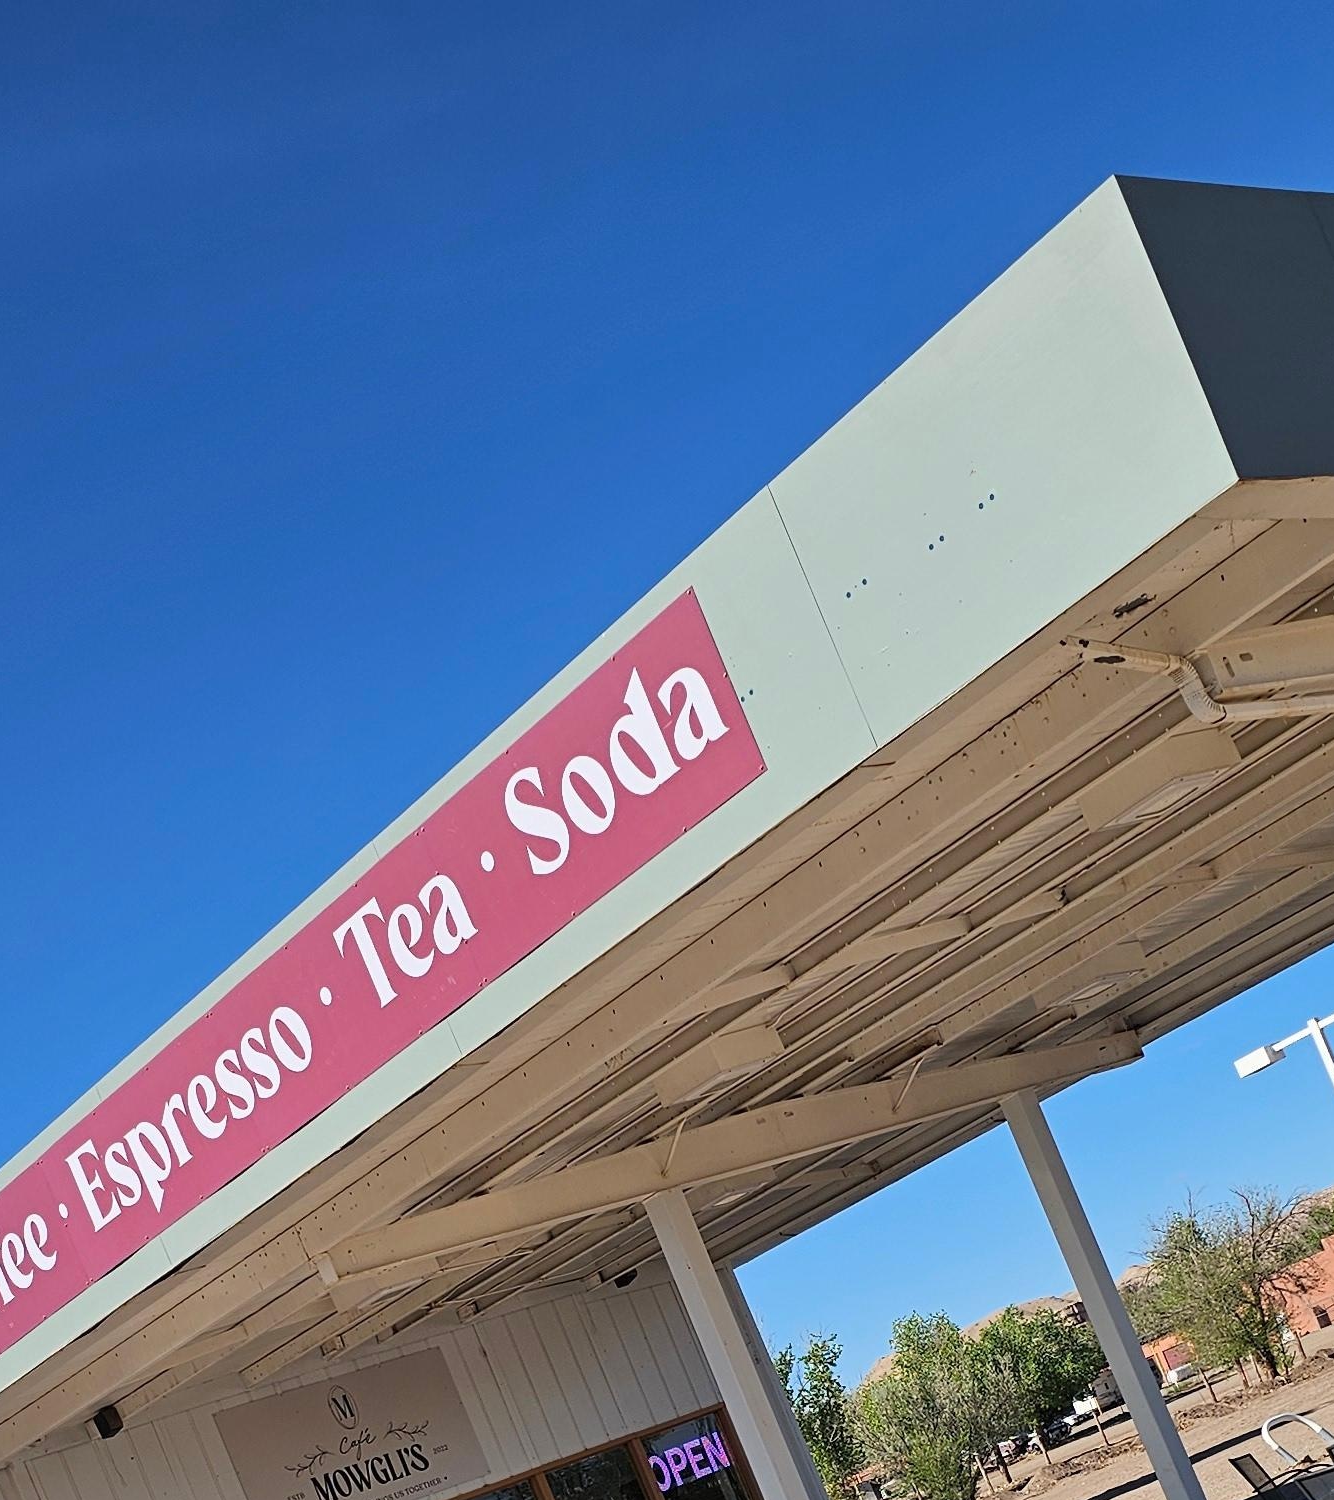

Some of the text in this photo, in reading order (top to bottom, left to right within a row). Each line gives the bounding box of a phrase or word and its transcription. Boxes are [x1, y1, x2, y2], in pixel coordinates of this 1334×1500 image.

[66, 1004, 313, 1232] Espresso
[333, 873, 477, 1008] Tea
[504, 666, 730, 875] Soda
[331, 1395, 355, 1421] M
[339, 1428, 377, 1461] Café
[648, 1431, 731, 1492] OPEN
[394, 1491, 405, 1500] US
[405, 1477, 442, 1496] TOGETHER
